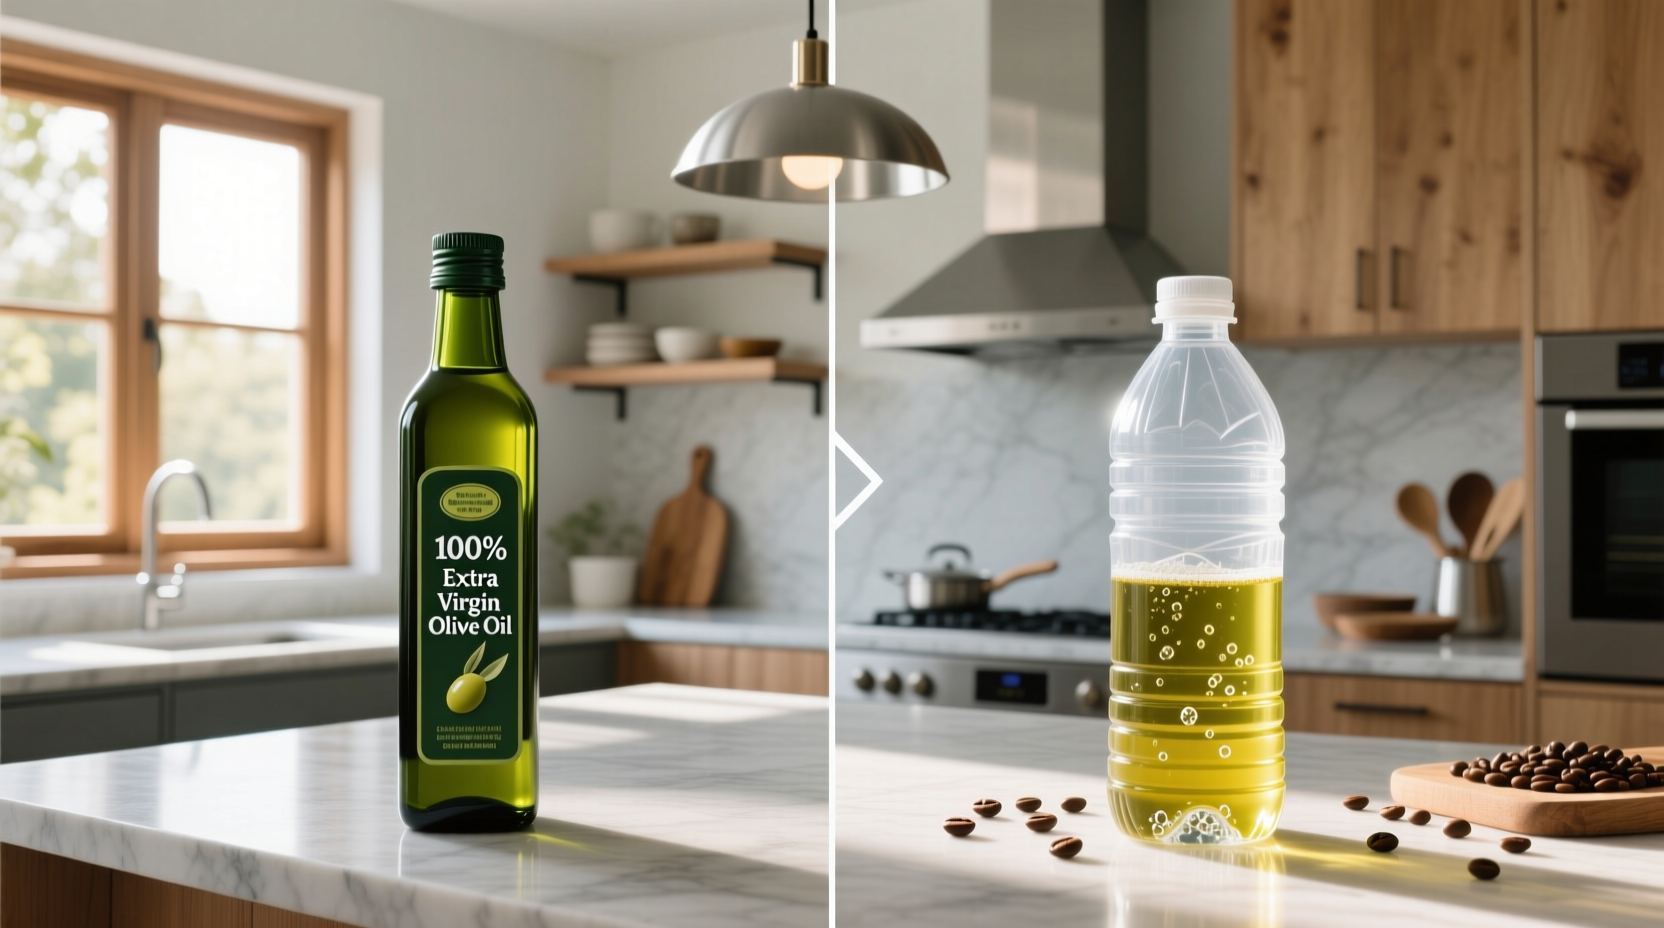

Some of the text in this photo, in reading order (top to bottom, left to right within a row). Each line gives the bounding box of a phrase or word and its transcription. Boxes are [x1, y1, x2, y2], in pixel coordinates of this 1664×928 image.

[435, 535, 508, 560] 100%
[442, 568, 499, 587] Extra
[437, 593, 501, 616] Virgin
[428, 615, 512, 635] Olive Oil
